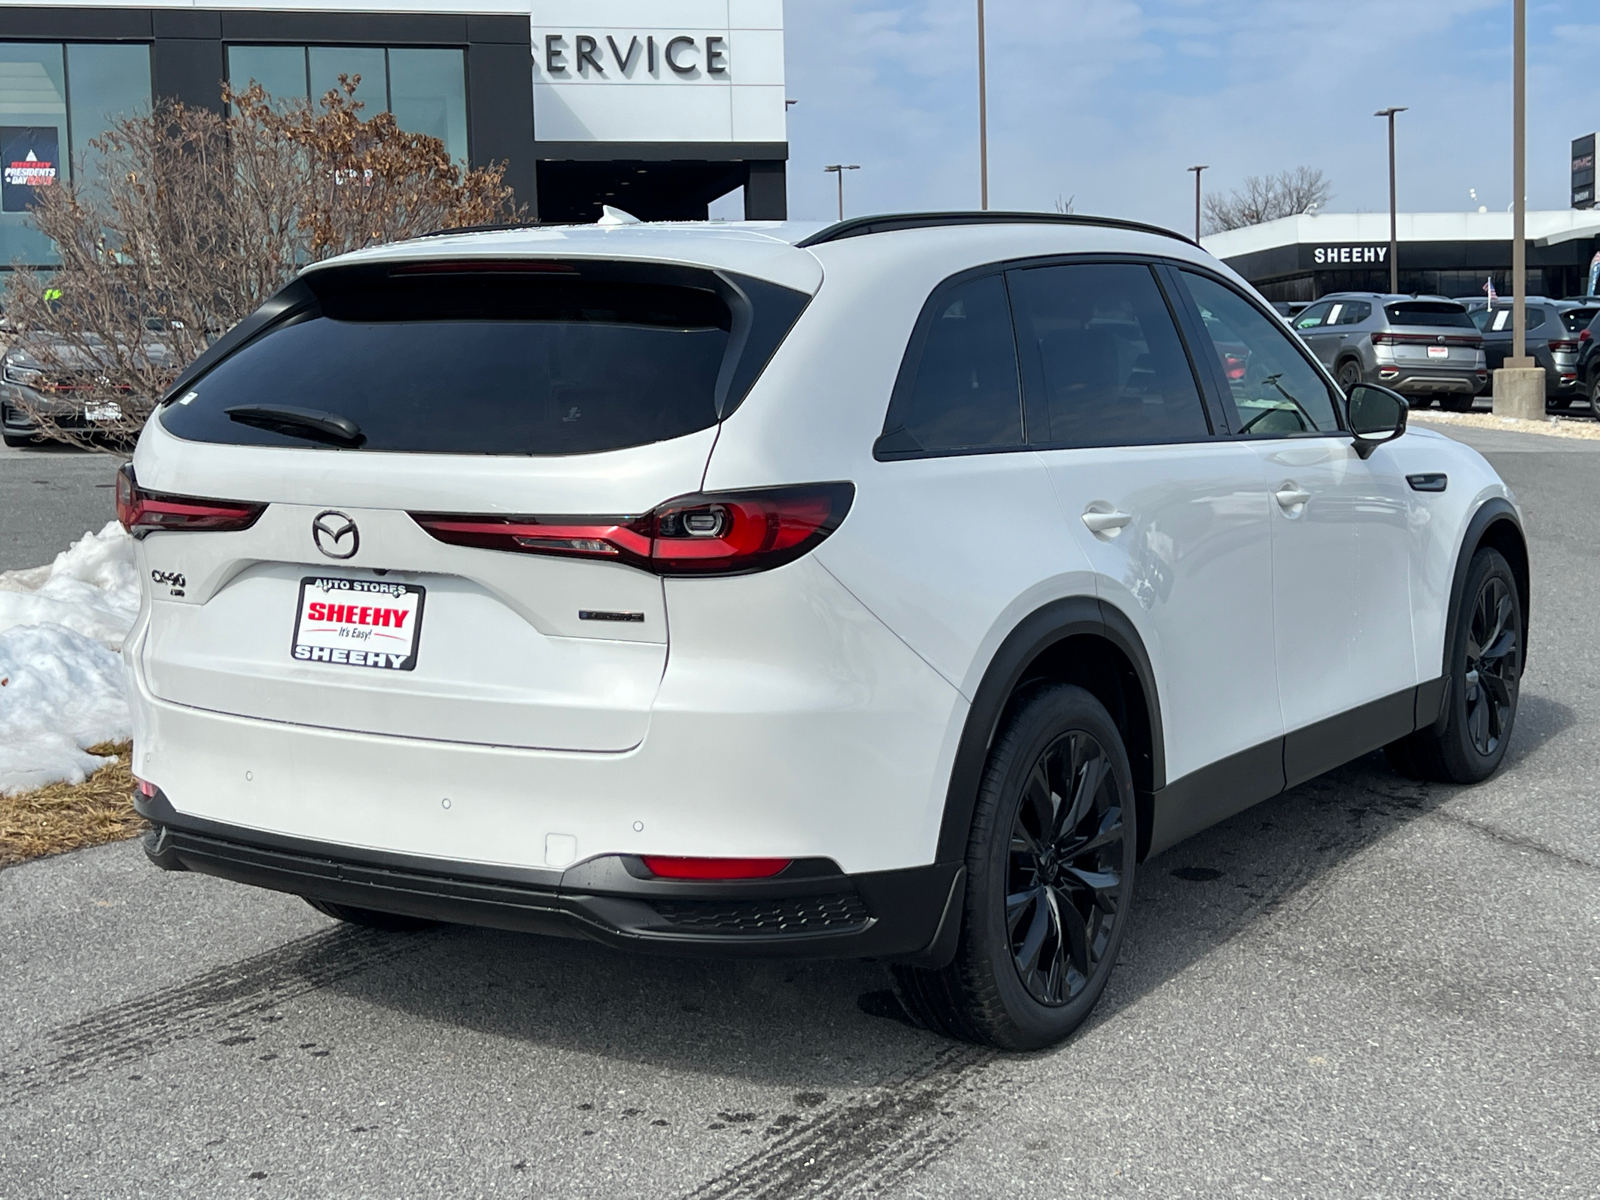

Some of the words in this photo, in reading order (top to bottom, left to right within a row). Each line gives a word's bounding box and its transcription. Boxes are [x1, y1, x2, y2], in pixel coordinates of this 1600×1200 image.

[532, 34, 727, 74] ERVICE
[4, 167, 56, 177] PRESIDENTS
[11, 176, 29, 185] DAY
[1314, 247, 1387, 264] SHEEHY
[314, 578, 350, 591] AUTO
[353, 581, 406, 595] STORES
[308, 602, 409, 629] SHEEHY
[338, 626, 350, 638] It's
[352, 627, 373, 642] Easy!
[294, 645, 408, 669] SHEEHY
